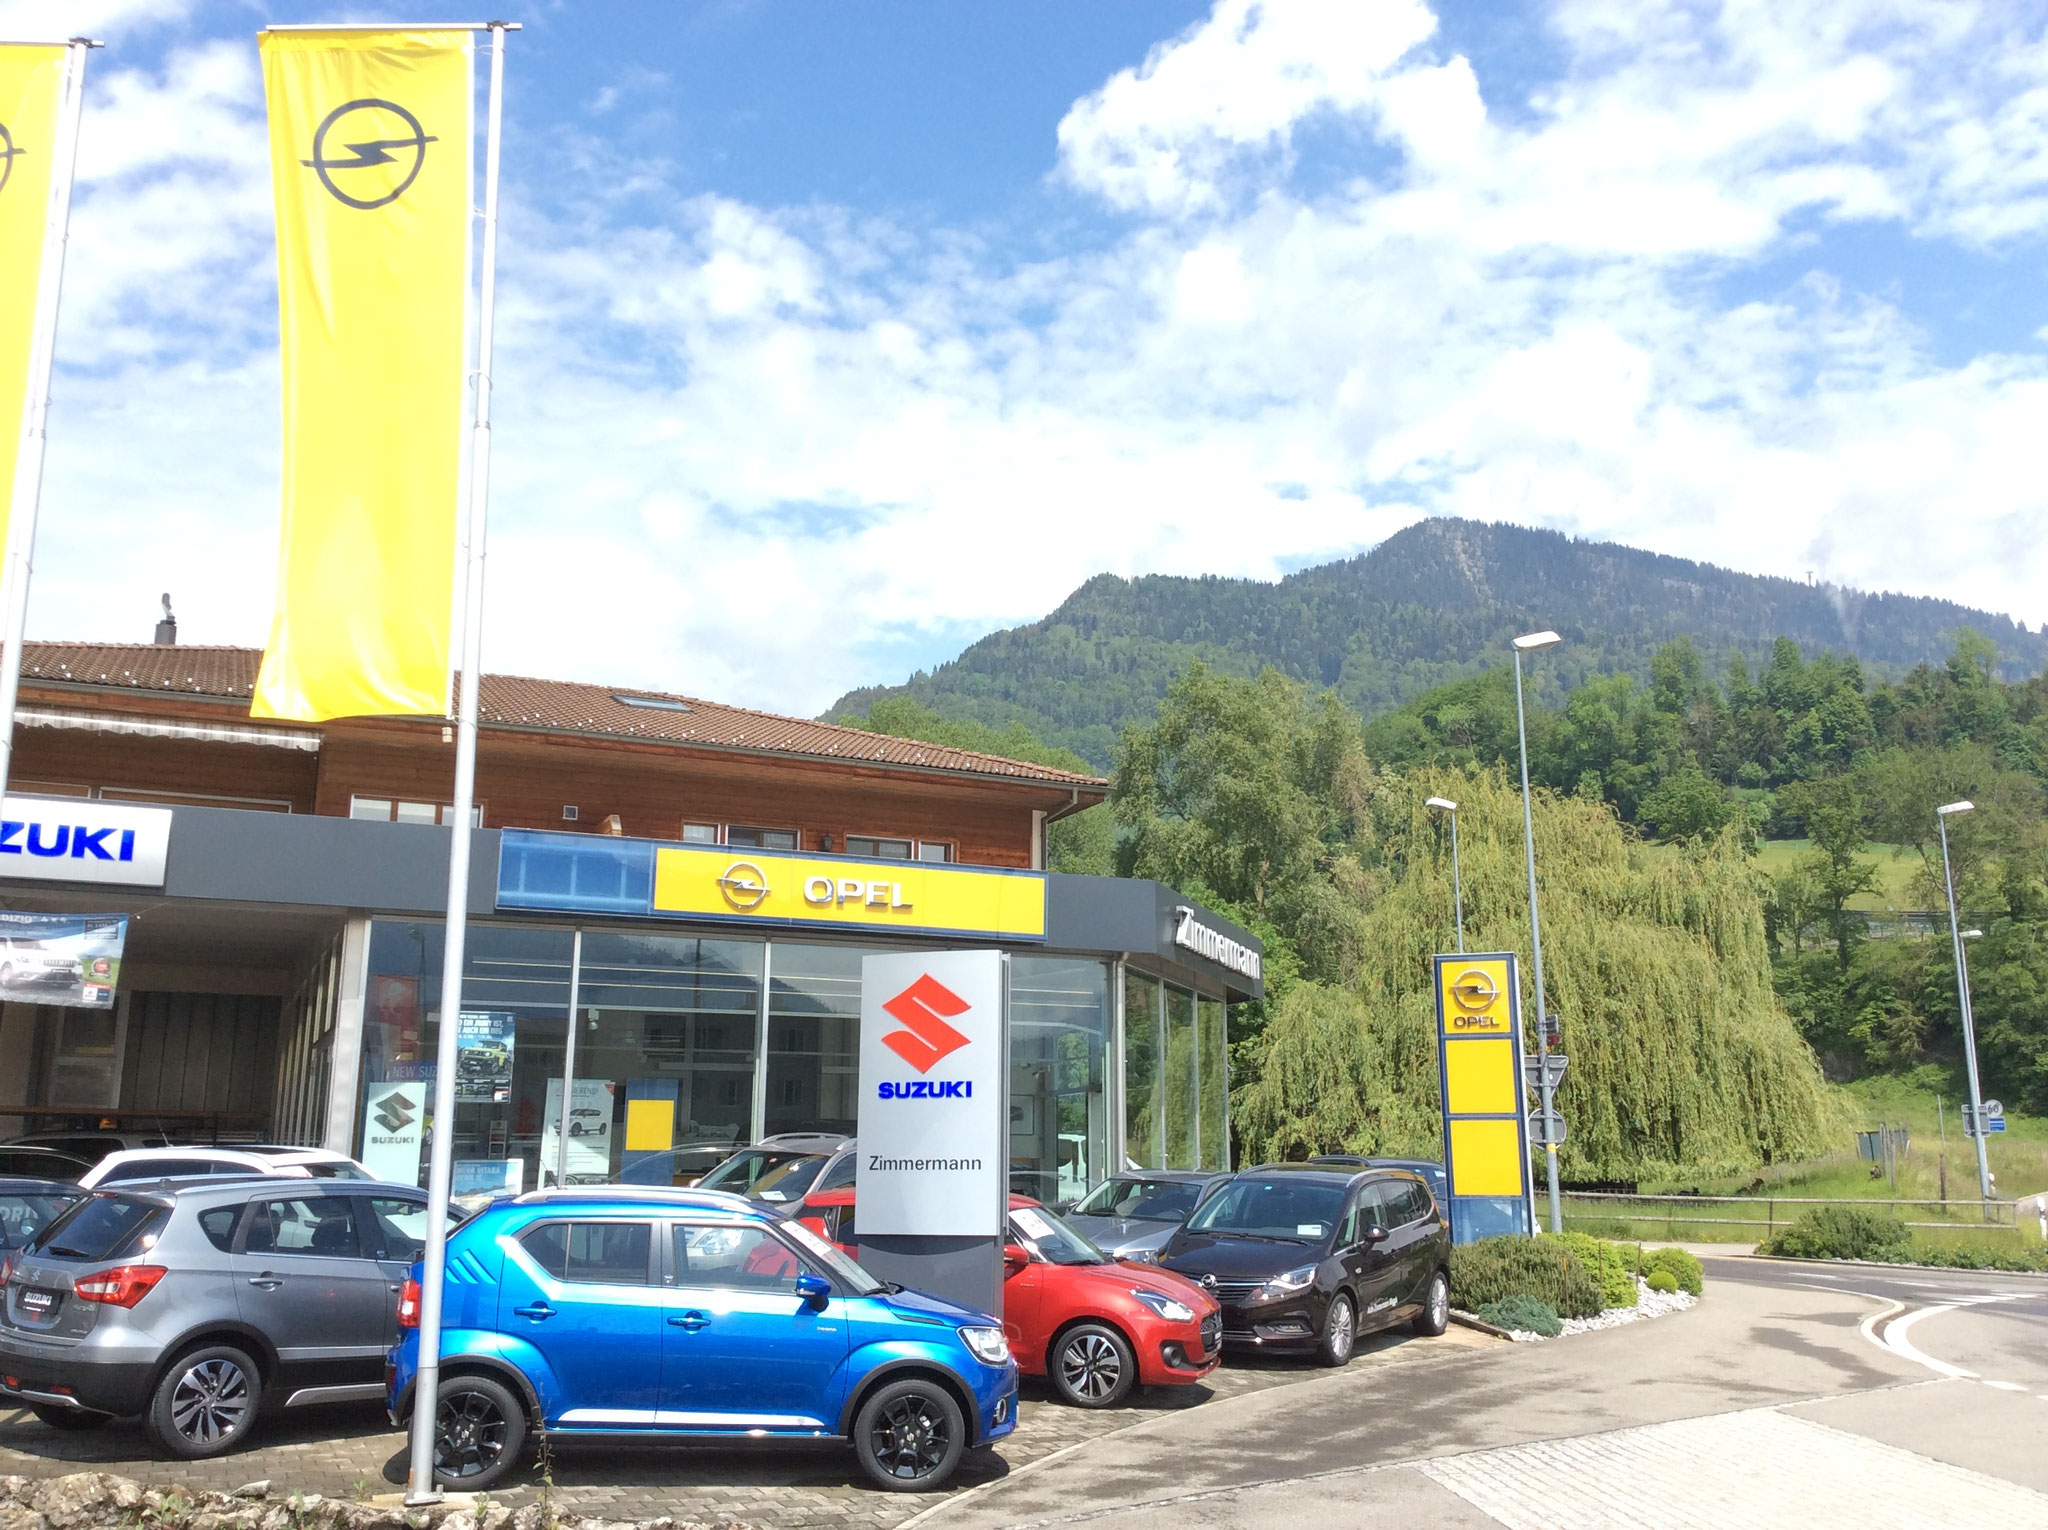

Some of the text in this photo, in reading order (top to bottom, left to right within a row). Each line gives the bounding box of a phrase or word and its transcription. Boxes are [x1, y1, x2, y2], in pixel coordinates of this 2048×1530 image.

[803, 876, 913, 908] OPEL
[1175, 905, 1260, 980] Zimmermann
[1453, 1015, 1500, 1029] OPEL
[392, 1065, 437, 1078] NEW SUZ
[878, 1081, 972, 1099] SUZUKI
[1987, 1104, 1999, 1114] 60
[371, 1136, 415, 1144] SUZUKI
[868, 1155, 982, 1171] Zimmermann
[24, 1291, 52, 1306] SUZUKI
